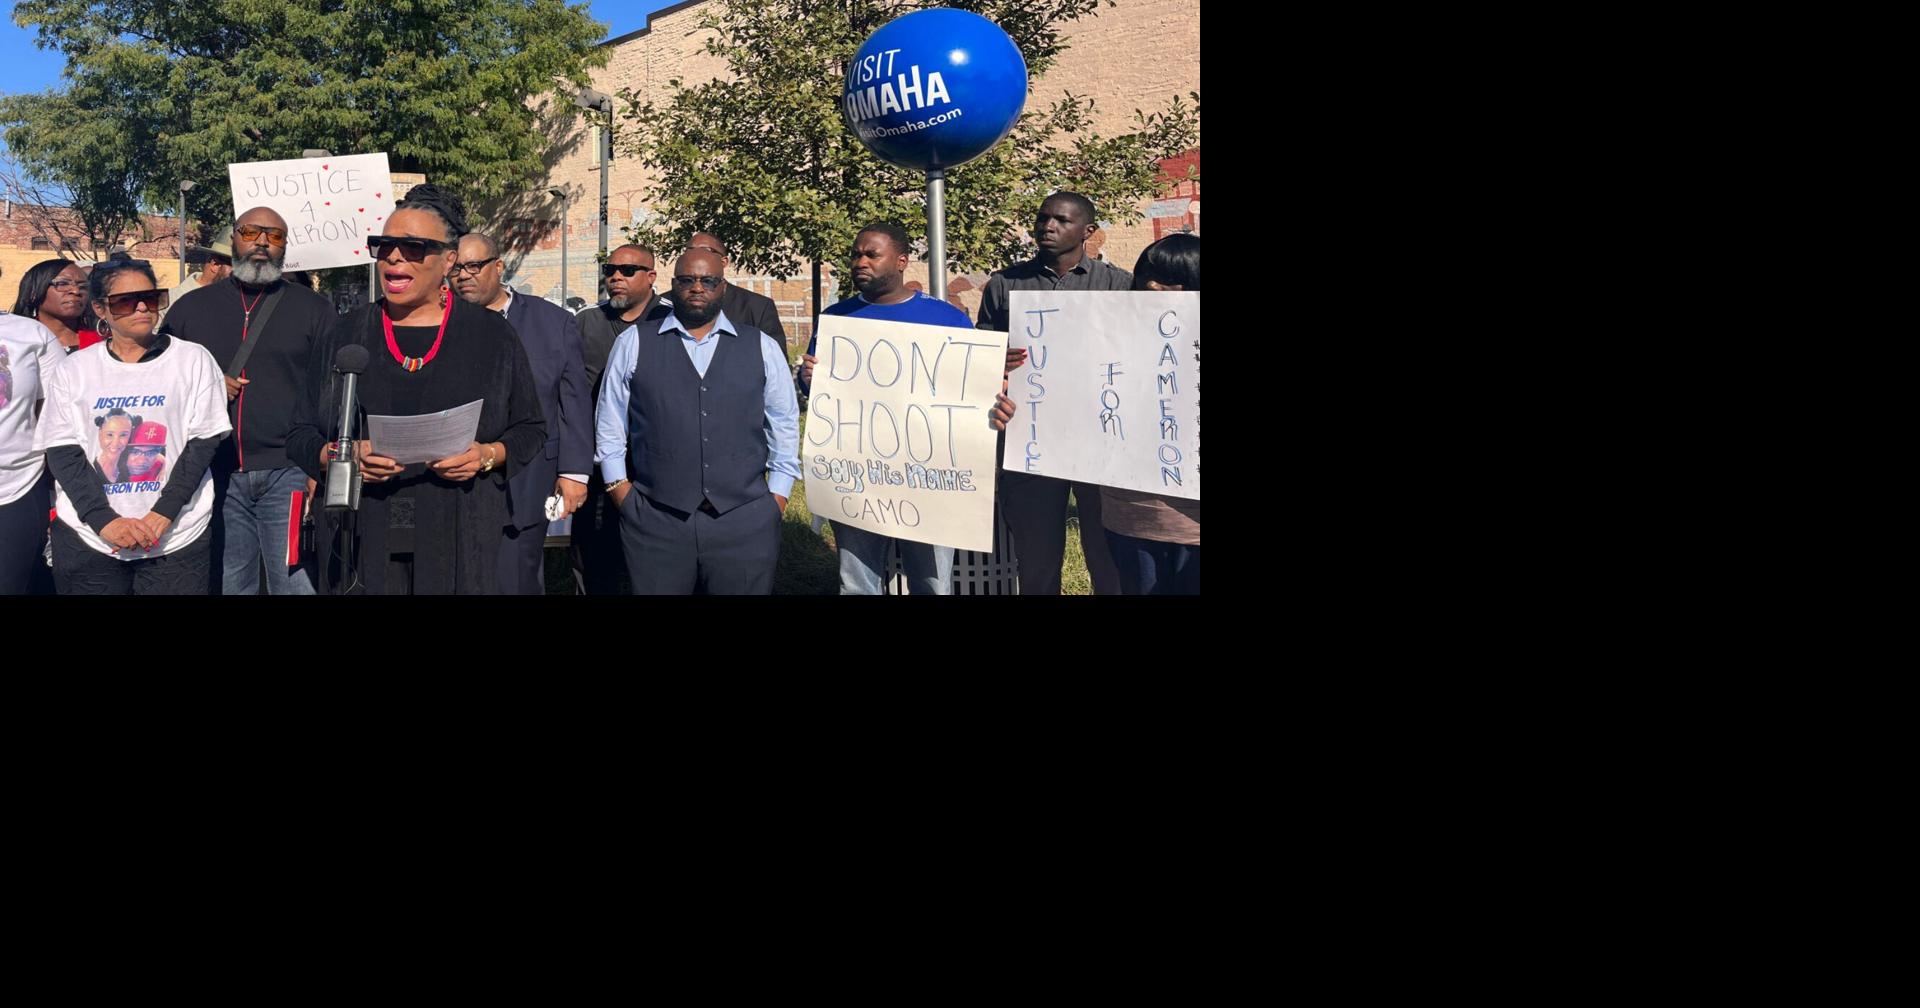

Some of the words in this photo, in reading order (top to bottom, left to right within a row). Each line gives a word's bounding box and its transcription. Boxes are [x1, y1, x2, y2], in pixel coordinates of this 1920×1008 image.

[848, 48, 901, 90] VISIT
[846, 64, 952, 123] OMAHA
[246, 169, 362, 199] JUSTICE
[287, 216, 359, 248] ERON
[300, 200, 316, 223] 4
[829, 335, 1001, 401] DON'T
[93, 396, 141, 409] JUSTICE
[141, 395, 166, 407] FOR
[1025, 308, 1060, 473] JUSTICE
[1099, 361, 1125, 441] FOR
[1157, 309, 1183, 487] CAMERON
[807, 392, 980, 468] SHOOT
[103, 482, 133, 496] ERON
[134, 481, 161, 493] FORD
[840, 496, 921, 528] CAMO
